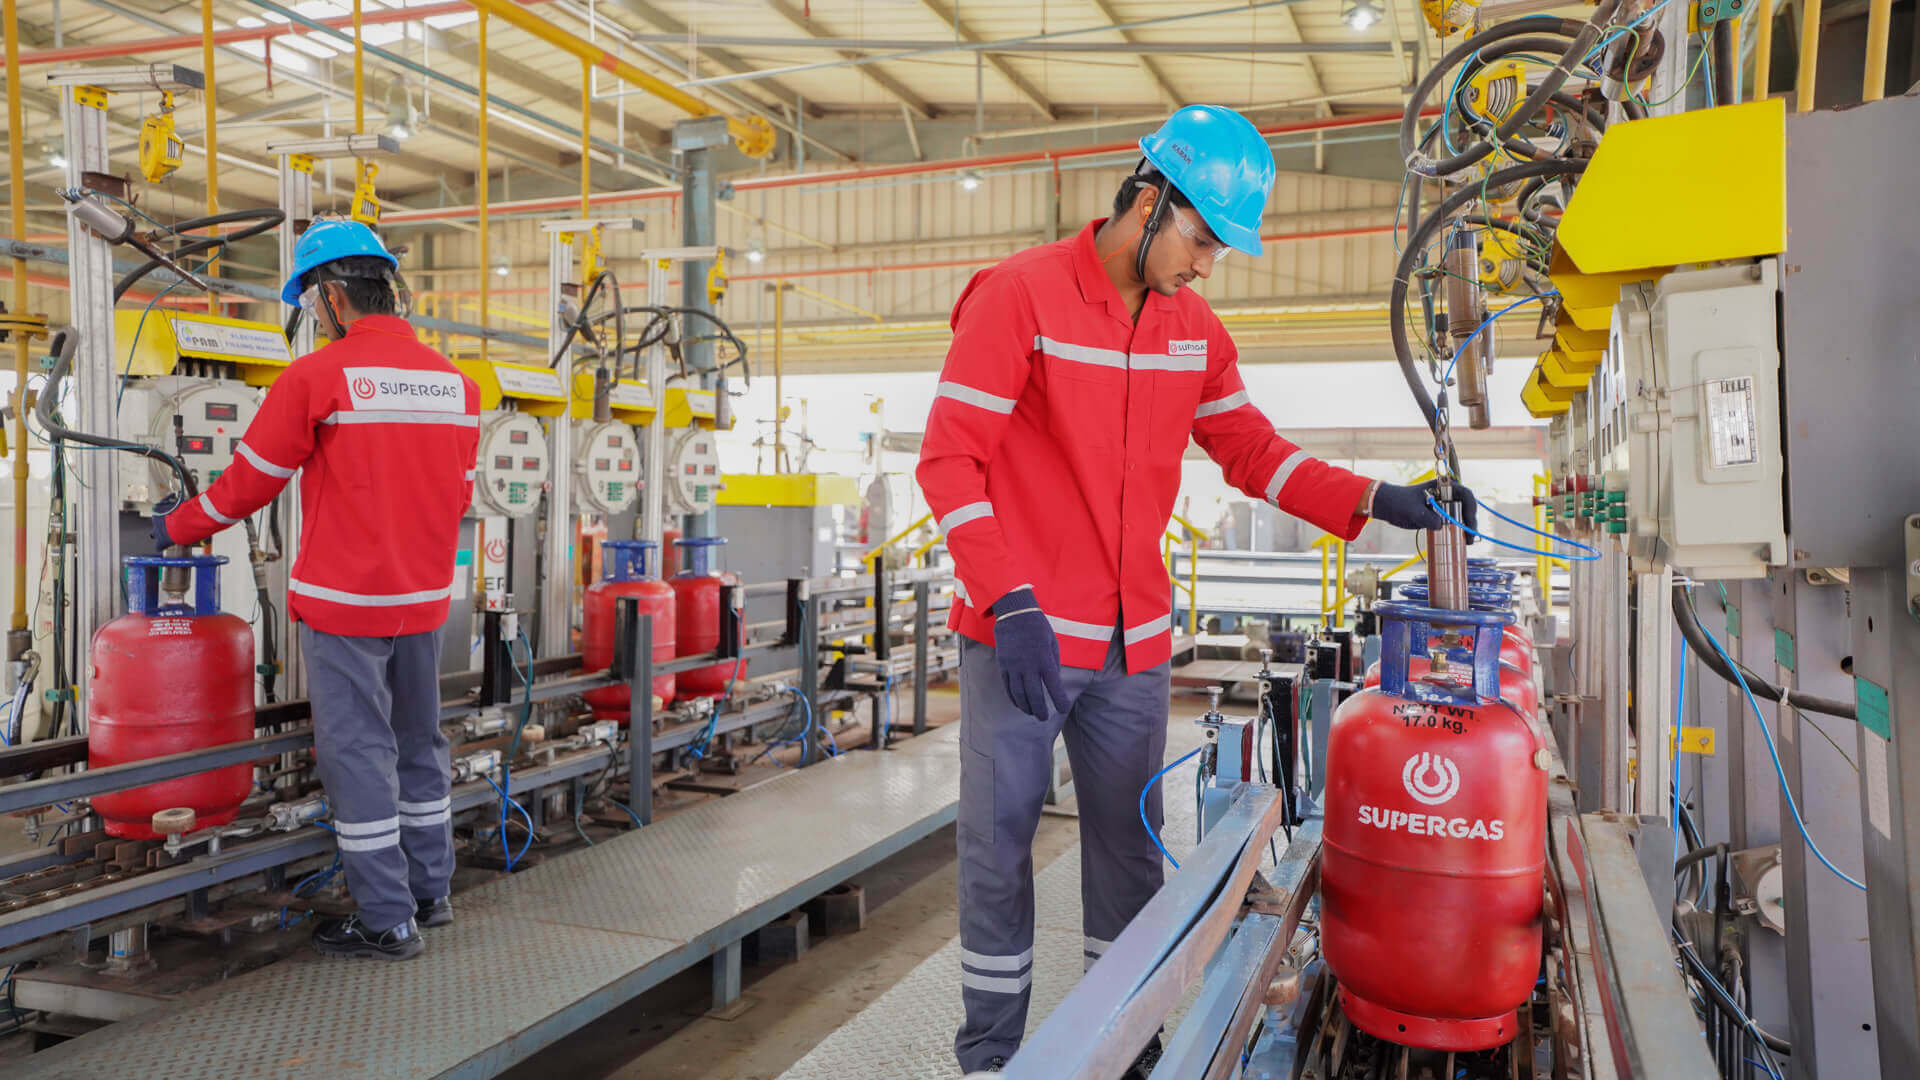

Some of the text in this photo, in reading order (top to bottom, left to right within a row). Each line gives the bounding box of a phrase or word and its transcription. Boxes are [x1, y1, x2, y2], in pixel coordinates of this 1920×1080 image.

[379, 381, 457, 399] SUPERGAS
[1402, 715, 1468, 734] 17.0 kg.
[1357, 804, 1505, 841] SUPERGAS
